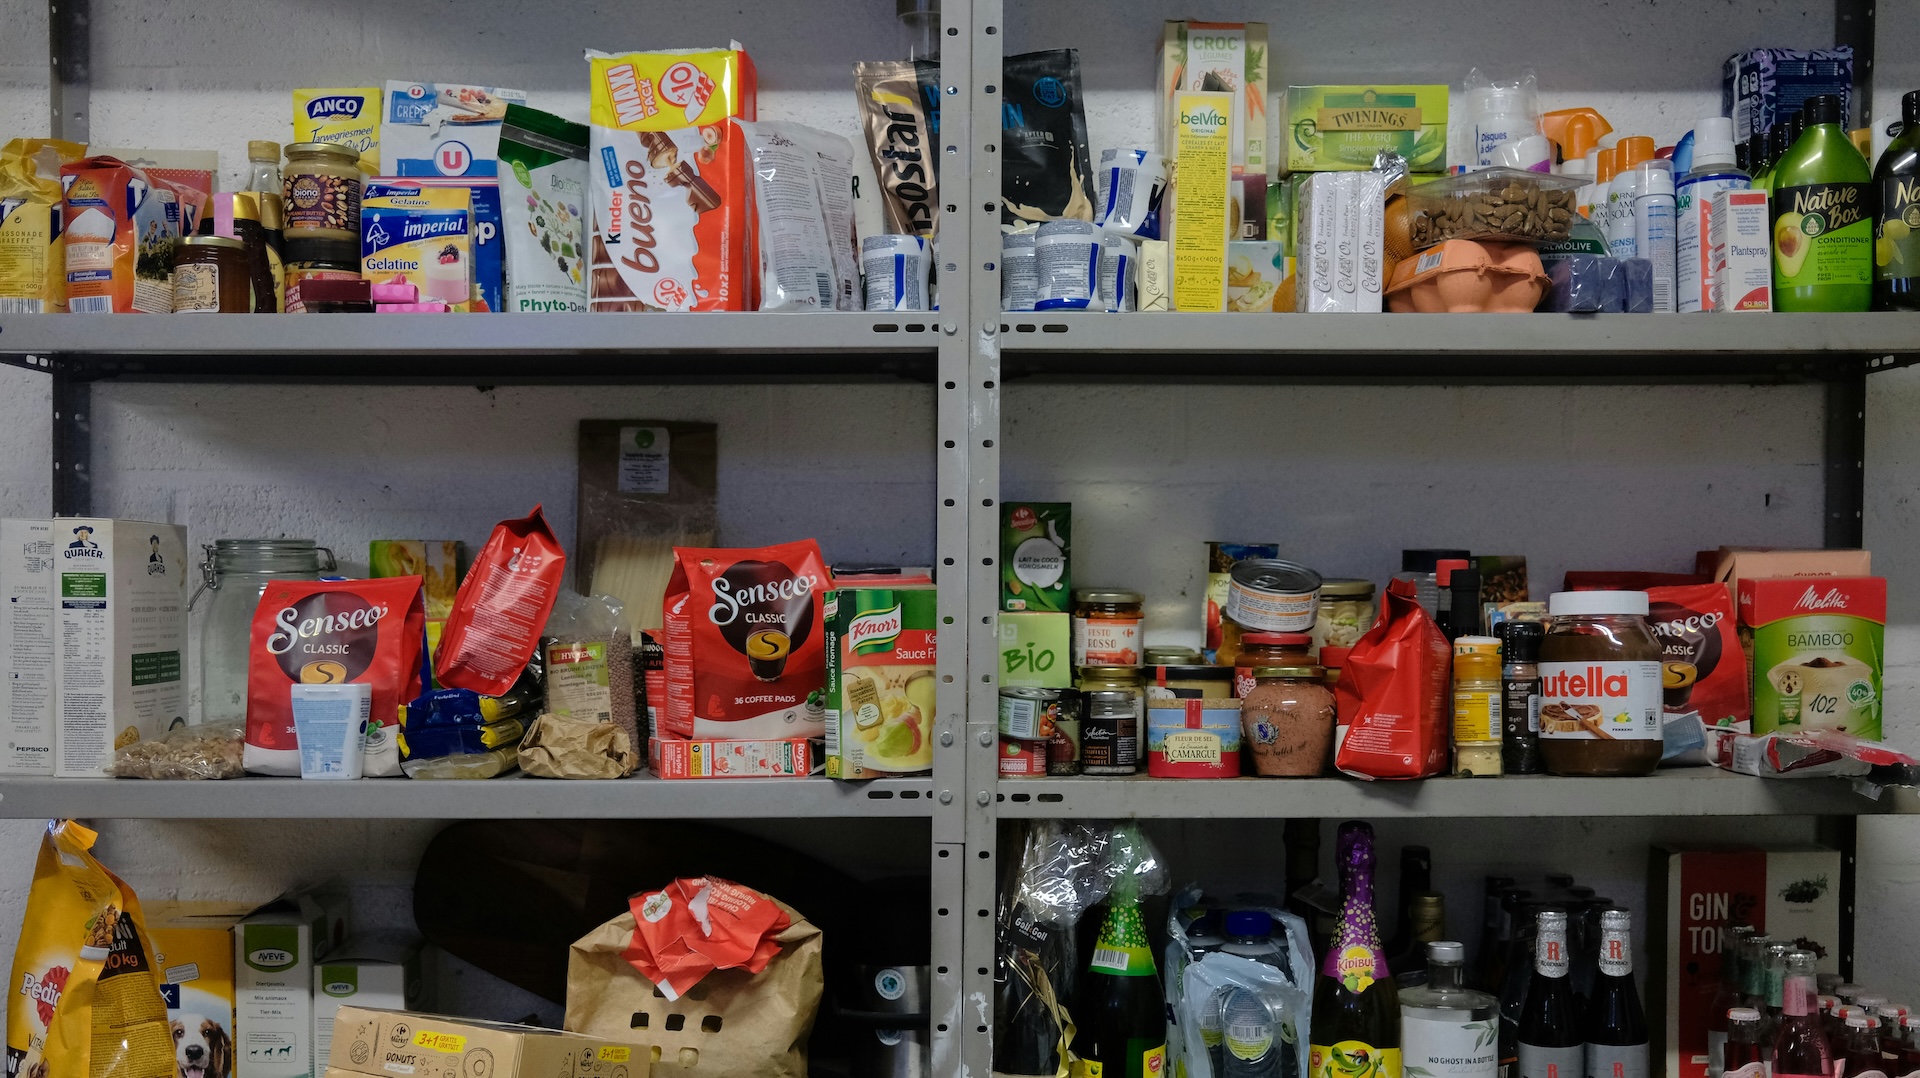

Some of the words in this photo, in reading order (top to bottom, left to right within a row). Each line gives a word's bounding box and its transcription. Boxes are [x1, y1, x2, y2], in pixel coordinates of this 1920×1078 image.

[1193, 36, 1238, 50] CROC
[607, 64, 645, 127] MAXI
[639, 78, 659, 117] PACK
[312, 100, 358, 116] ANCO
[1181, 109, 1227, 126] belVita
[1332, 110, 1407, 128] TWININGS
[311, 125, 374, 144] Tarwegriesmeel
[1480, 132, 1507, 142] Disques
[359, 136, 379, 153] Dur
[443, 150, 463, 170] U
[294, 188, 318, 198] biona
[386, 189, 419, 197] imperial
[1793, 185, 1857, 214] Nature
[389, 197, 431, 206] Gelatine
[605, 190, 624, 244] kinder
[620, 160, 660, 274] bueno
[1828, 203, 1861, 229] Box
[403, 217, 463, 238] imperial
[1817, 236, 1870, 245] CONDITIONER
[1730, 245, 1768, 258] Plantspray
[366, 258, 419, 270] Gelatine
[63, 548, 104, 559] QUAKER
[147, 565, 166, 576] QUAKER
[708, 574, 818, 626] Senseo
[1792, 584, 1848, 611] Melitta
[745, 613, 787, 624] CLASSIC
[266, 603, 390, 656] Senseo
[850, 618, 899, 641] Knorr
[1088, 629, 1111, 637] PESTO
[1087, 638, 1117, 649] ROSSO
[1788, 633, 1854, 647] BAMBOO
[303, 643, 350, 655] CLASSIC
[829, 631, 838, 668] Fromage
[896, 648, 926, 660] Sauce
[1662, 645, 1695, 656] ASSIC
[829, 668, 837, 693] Sauce
[747, 697, 772, 705] COFFEE
[774, 696, 796, 704] PADS
[1809, 693, 1838, 715] 102
[286, 726, 296, 734] 36
[797, 743, 805, 773] Royco
[1171, 749, 1217, 759] CAMARGUE
[1689, 892, 1729, 921] GIN
[1014, 916, 1030, 931] Gall
[1032, 927, 1048, 942] Gall
[257, 952, 285, 961] AVEVE
[1546, 941, 1560, 961] R
[1607, 940, 1623, 960] R
[419, 1033, 440, 1047] 3+1
[440, 1035, 458, 1044] GRATIS
[438, 1043, 460, 1051] GRATUIT
[386, 1051, 417, 1065] DONUTS
[601, 1048, 615, 1059] 3+1
[1440, 1056, 1465, 1065] GHOST
[1464, 1056, 1472, 1065] IN
[1472, 1056, 1477, 1064] A
[1477, 1054, 1494, 1064] BOTTLE
